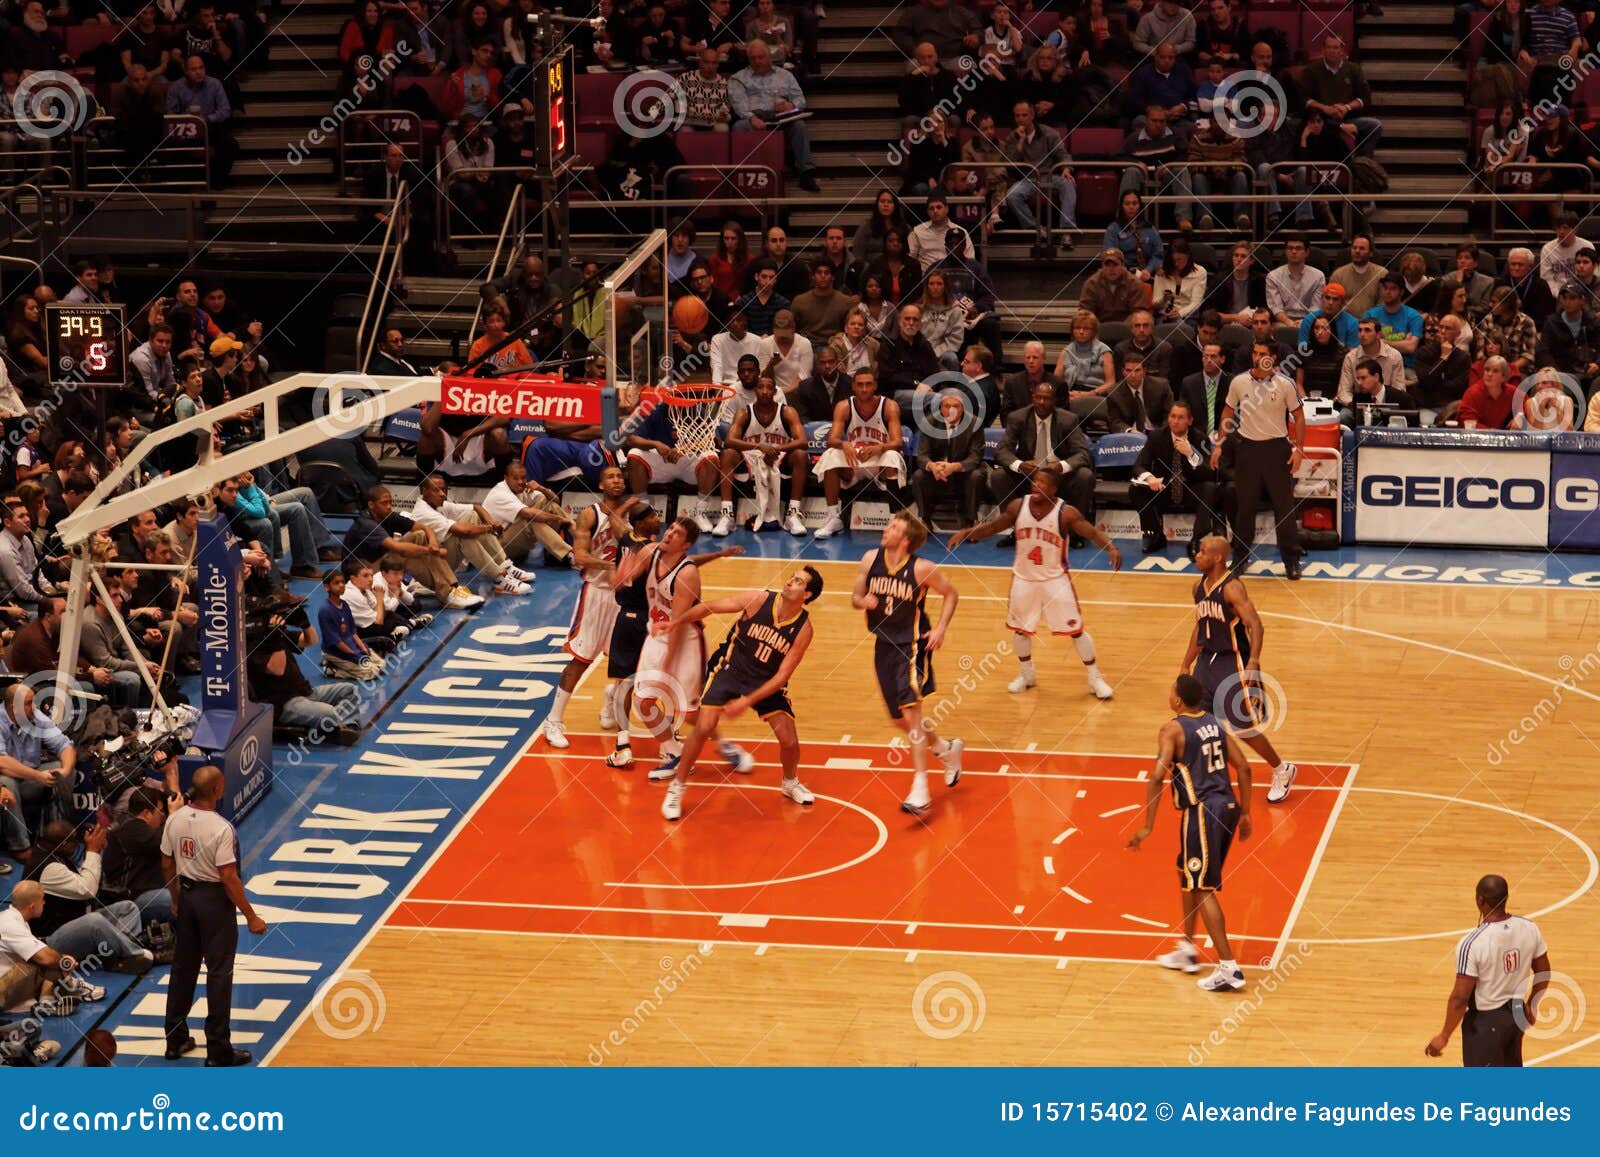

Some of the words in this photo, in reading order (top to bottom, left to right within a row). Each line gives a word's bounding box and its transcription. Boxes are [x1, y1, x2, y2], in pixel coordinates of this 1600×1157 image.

[60, 316, 103, 337] 39.9
[90, 343, 106, 370] 5
[446, 385, 513, 415] State
[514, 390, 583, 418] Farm
[1361, 475, 1546, 511] GEICO
[1027, 546, 1043, 566] 4
[868, 576, 914, 602] INDIANA
[746, 622, 792, 656] INDIANA
[753, 641, 773, 664] 10
[1201, 740, 1226, 774] 25
[236, 803, 451, 926] YORK
[347, 624, 571, 780] KNICKS
